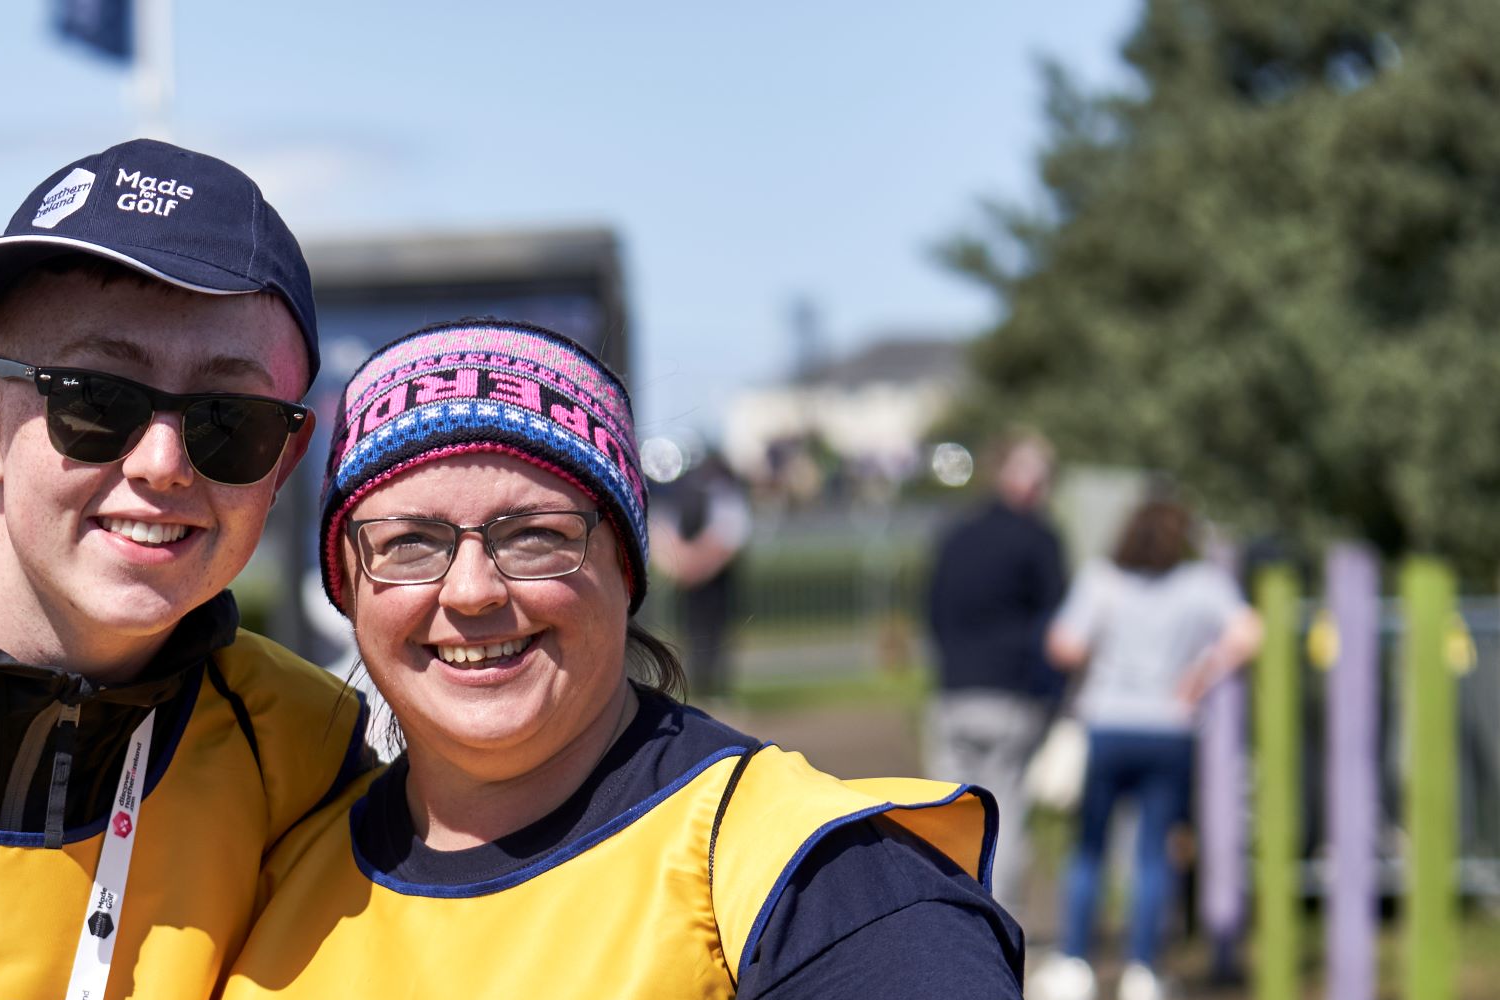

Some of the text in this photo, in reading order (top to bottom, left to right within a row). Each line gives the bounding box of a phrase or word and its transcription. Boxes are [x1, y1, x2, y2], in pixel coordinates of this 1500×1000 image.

[41, 182, 92, 208] Northern
[115, 167, 195, 200] Made
[139, 188, 158, 199] for
[116, 193, 179, 217] Golf
[338, 367, 644, 508] UPERD
[97, 887, 108, 909] Made
